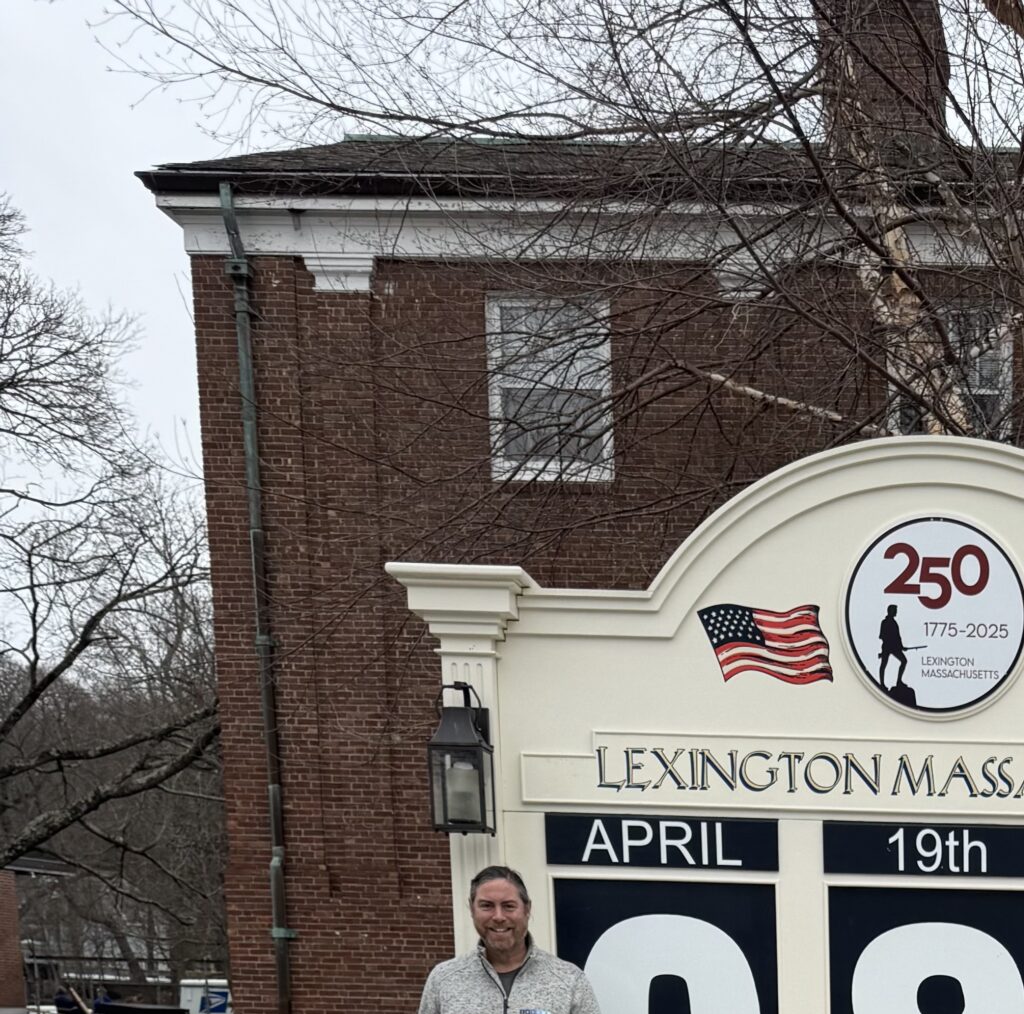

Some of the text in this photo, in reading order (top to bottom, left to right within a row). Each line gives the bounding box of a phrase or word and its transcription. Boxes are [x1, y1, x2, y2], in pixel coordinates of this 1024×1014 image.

[884, 542, 990, 610] 250
[924, 622, 1009, 639] 1775-2025
[921, 656, 975, 667] LEXINGTON
[921, 669, 1000, 680] MASSACHUSETTS
[597, 746, 882, 796] LEXINGTON
[581, 819, 742, 866] APRIL
[887, 828, 988, 873] 19th
